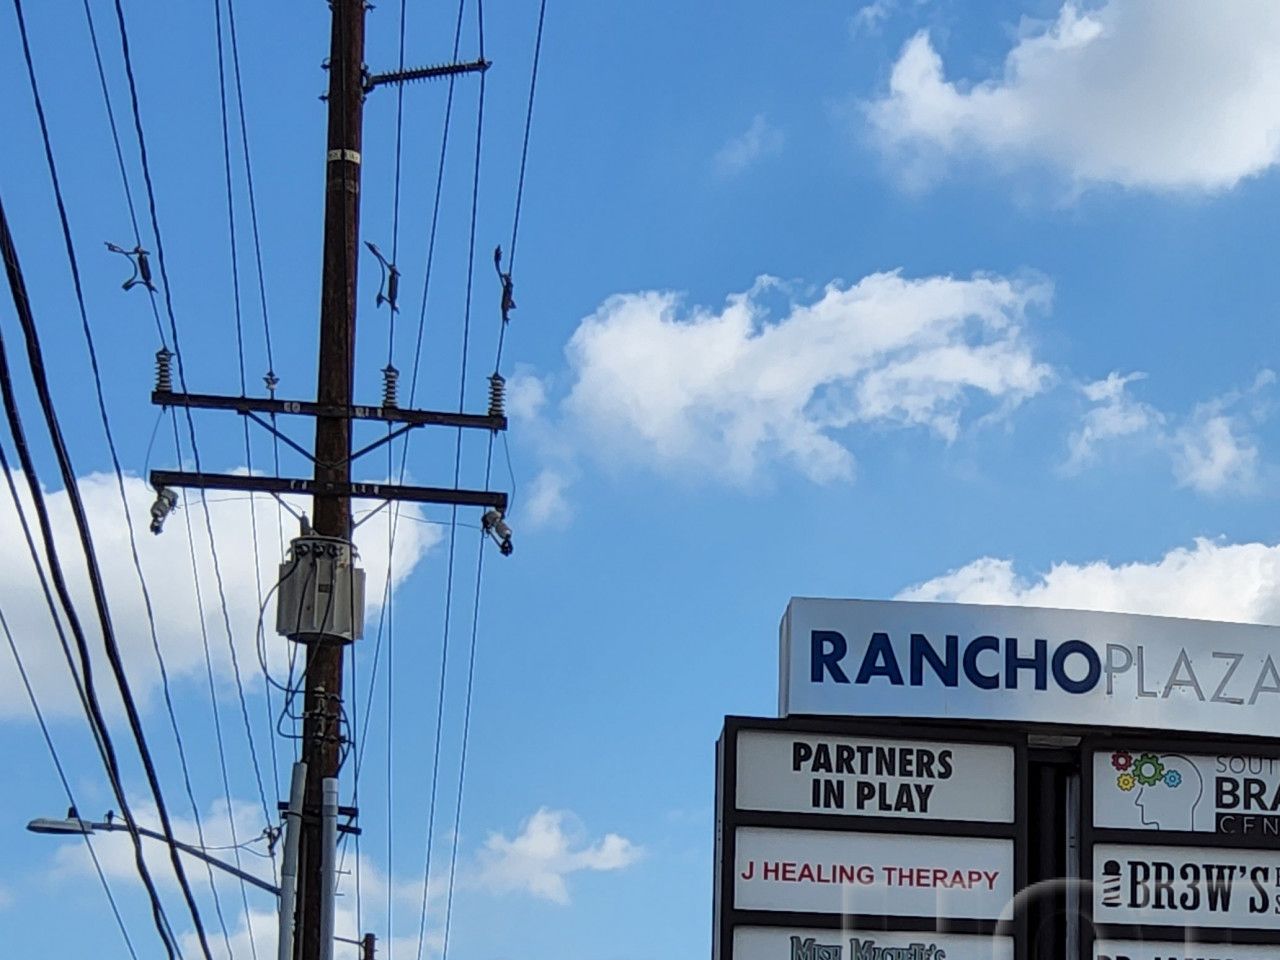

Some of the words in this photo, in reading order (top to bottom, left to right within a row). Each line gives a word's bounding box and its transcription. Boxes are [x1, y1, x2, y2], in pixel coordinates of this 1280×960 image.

[792, 741, 953, 780] PARTNERS
[811, 780, 846, 808] IN
[856, 781, 934, 813] PLAY
[741, 861, 755, 880] J
[763, 862, 875, 886] HEALING
[882, 867, 1000, 891] THERAPY
